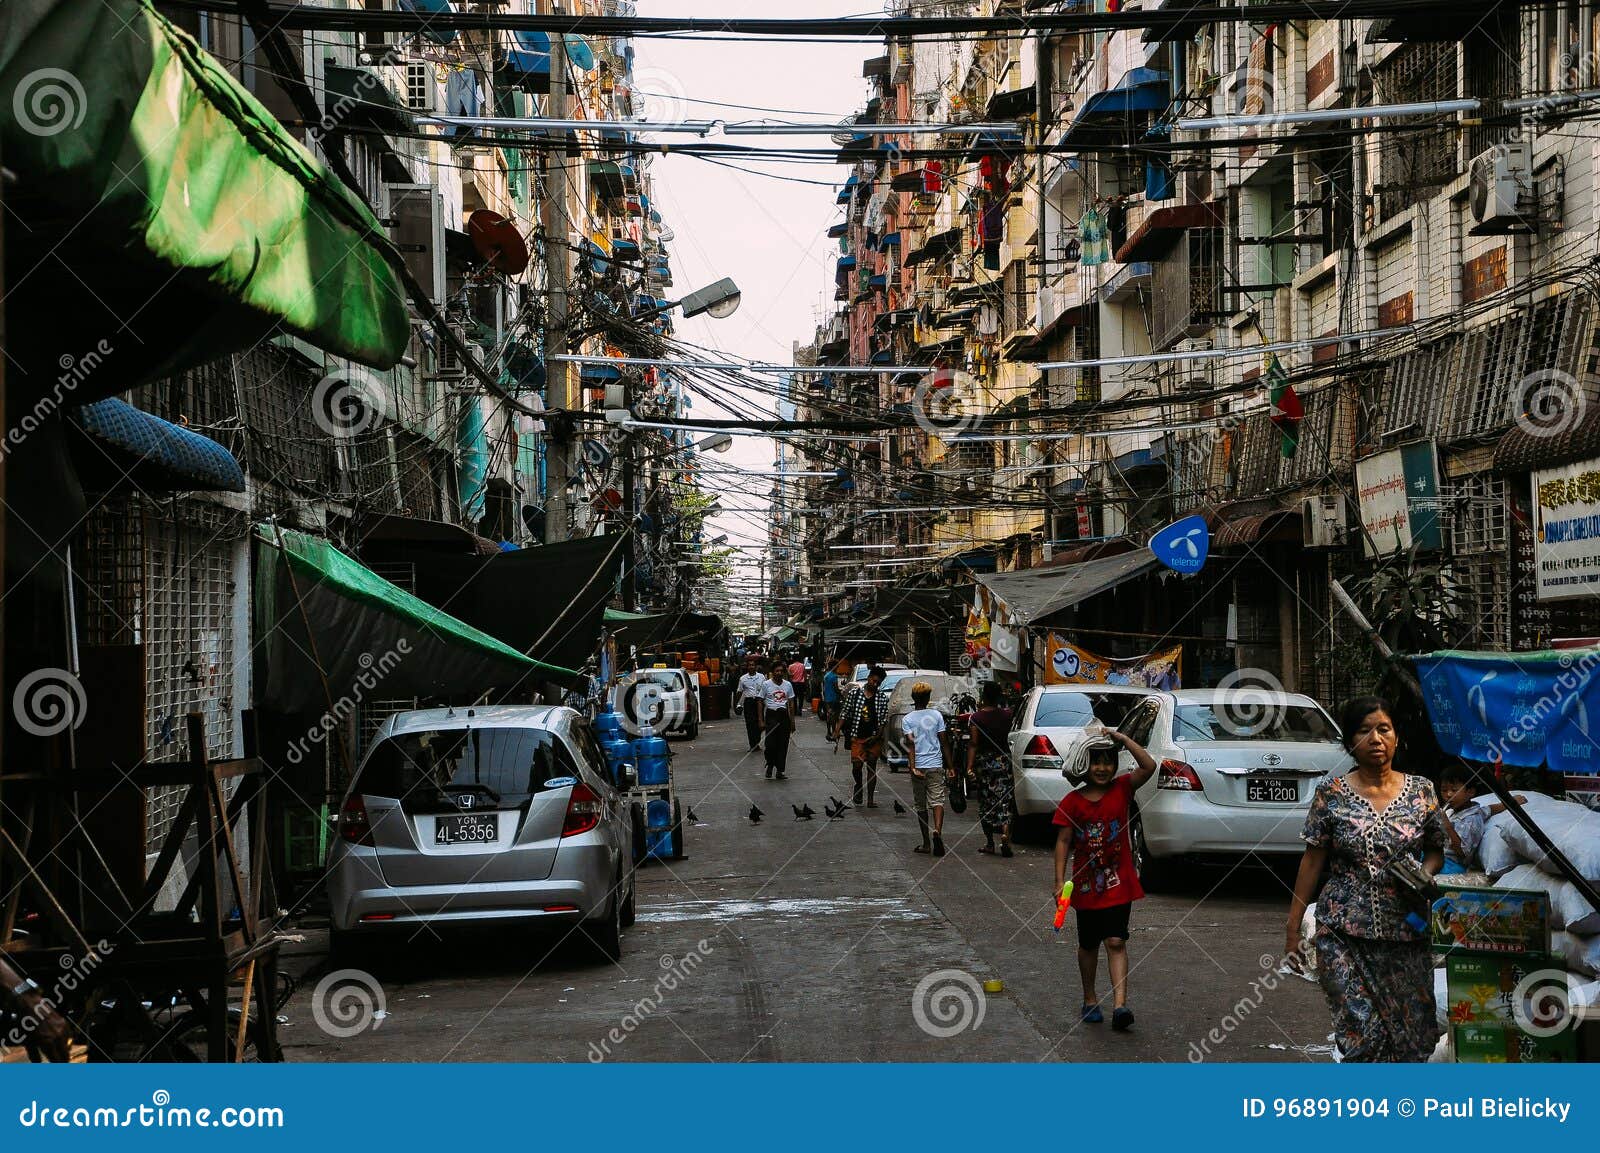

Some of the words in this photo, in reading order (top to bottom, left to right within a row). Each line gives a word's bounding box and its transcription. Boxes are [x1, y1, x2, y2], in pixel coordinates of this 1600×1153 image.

[1171, 557, 1200, 567] telenor
[1562, 739, 1592, 758] telenor
[1264, 779, 1281, 787] YGN
[1249, 786, 1296, 801] 5E-1200
[456, 816, 478, 825] YGN
[437, 824, 495, 842] 4L-5356
